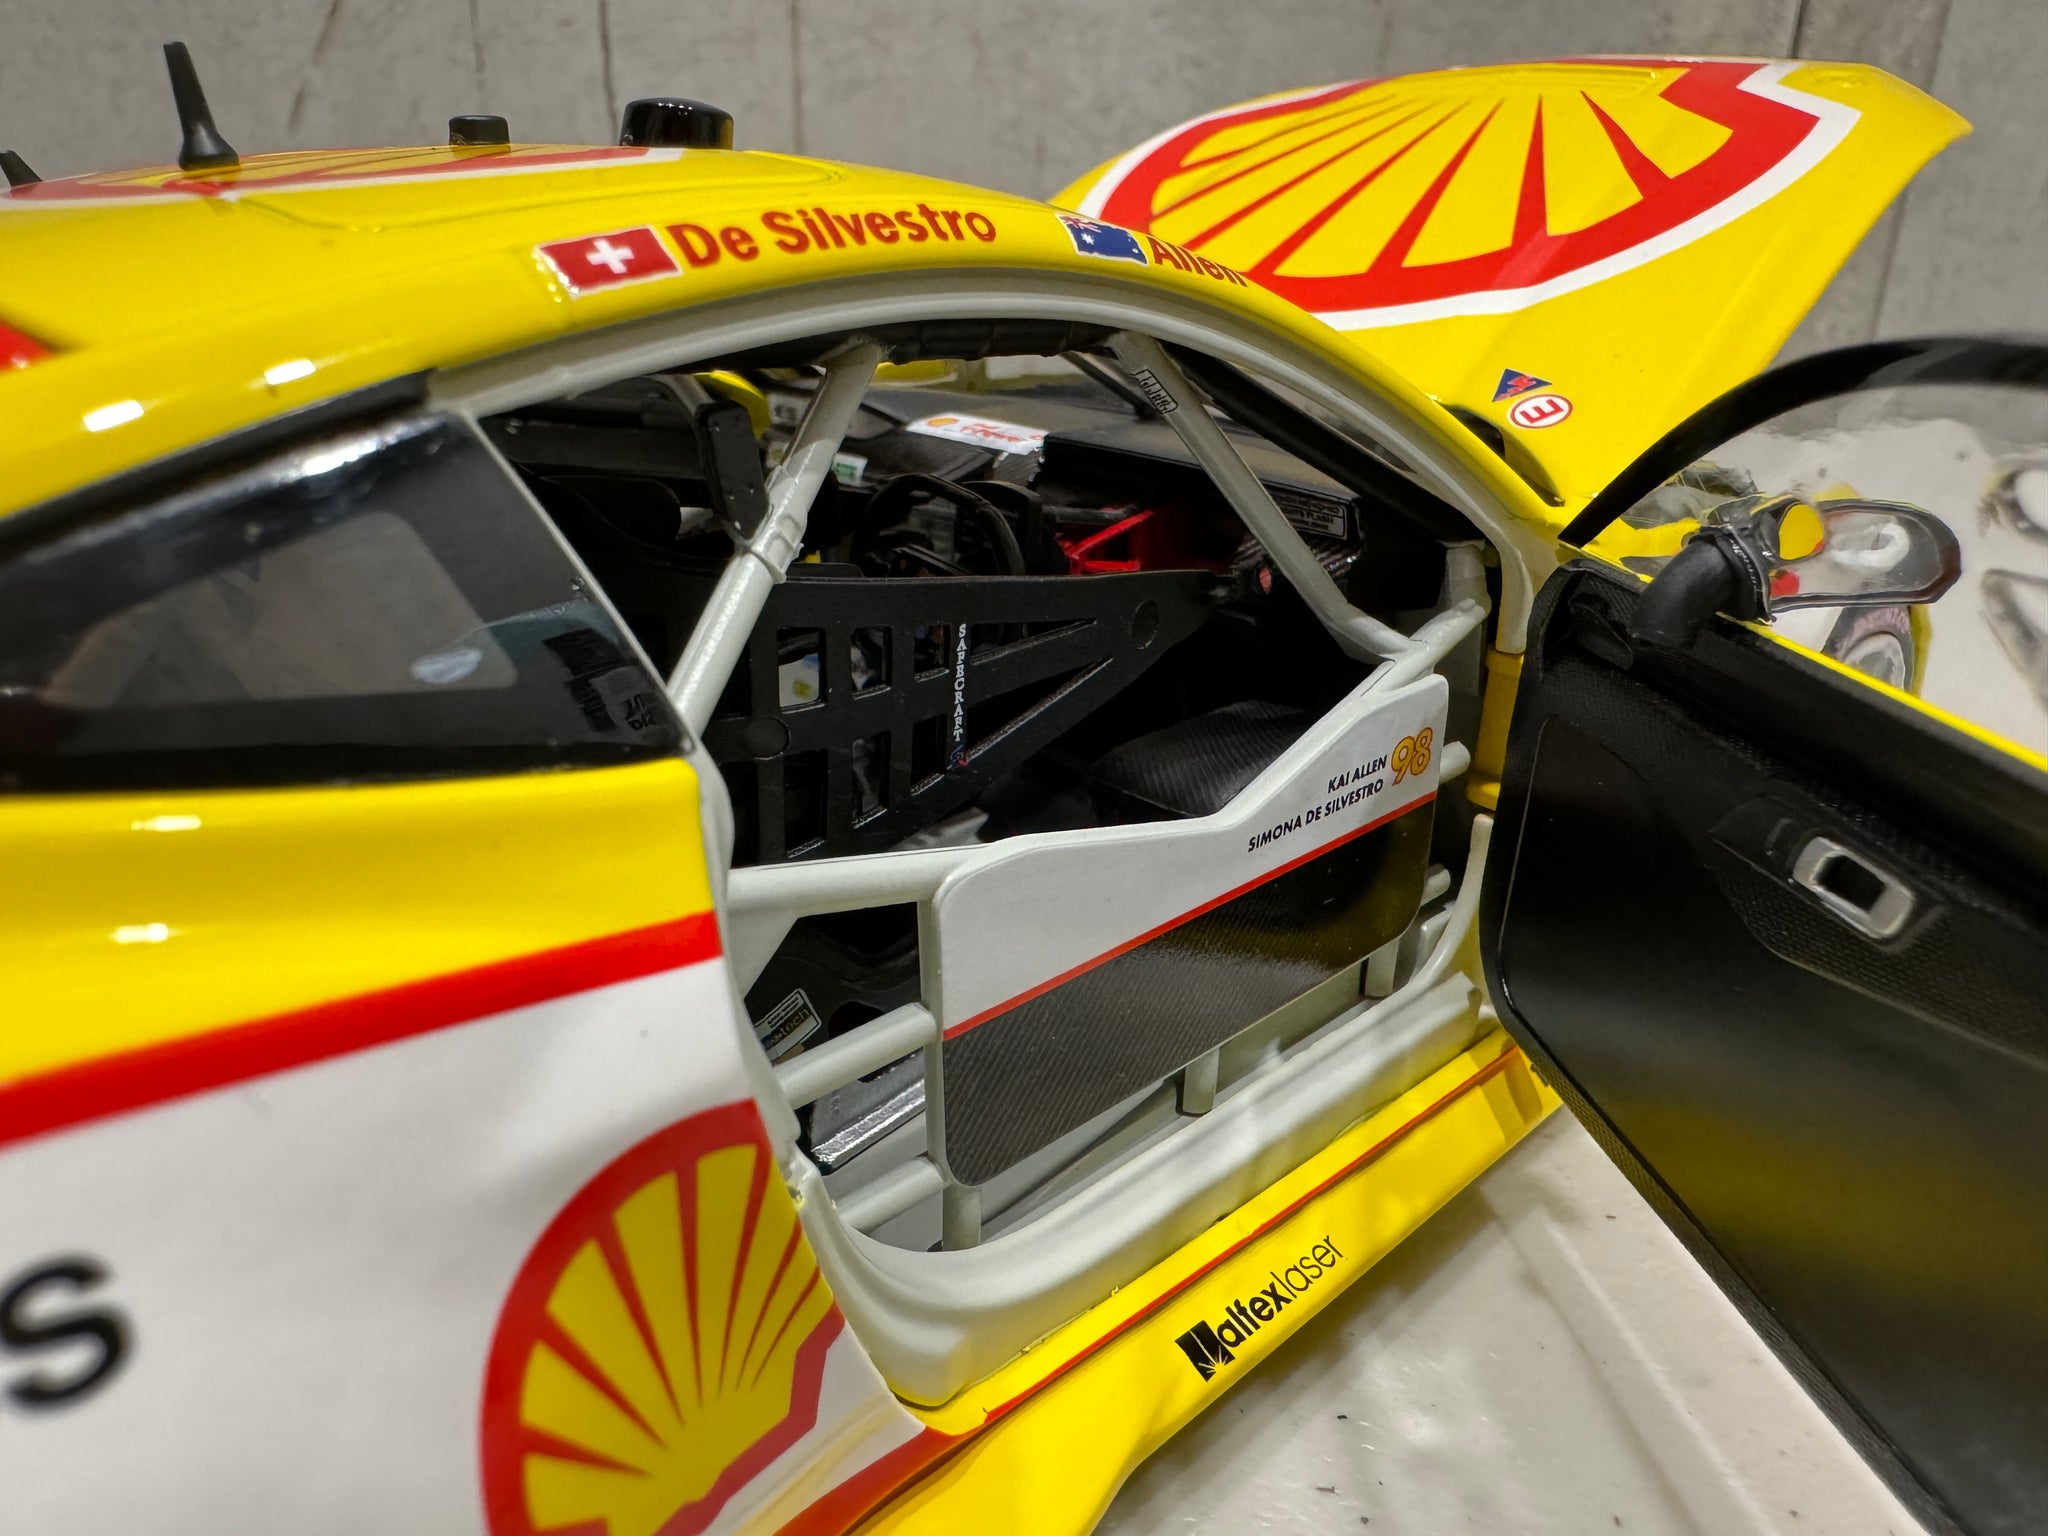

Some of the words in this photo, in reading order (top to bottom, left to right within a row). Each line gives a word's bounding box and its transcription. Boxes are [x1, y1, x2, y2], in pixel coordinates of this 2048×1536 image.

[665, 222, 760, 270] De
[761, 203, 997, 255] Silvestro
[1145, 234, 1248, 288] Allen
[1519, 398, 1564, 424] E
[1327, 770, 1350, 794] KAI
[1351, 755, 1388, 783] ALLEN
[1390, 727, 1434, 787] 98
[1247, 814, 1302, 853] SIMONA
[1305, 806, 1323, 827] DE
[1324, 779, 1384, 818] SILVESTRO
